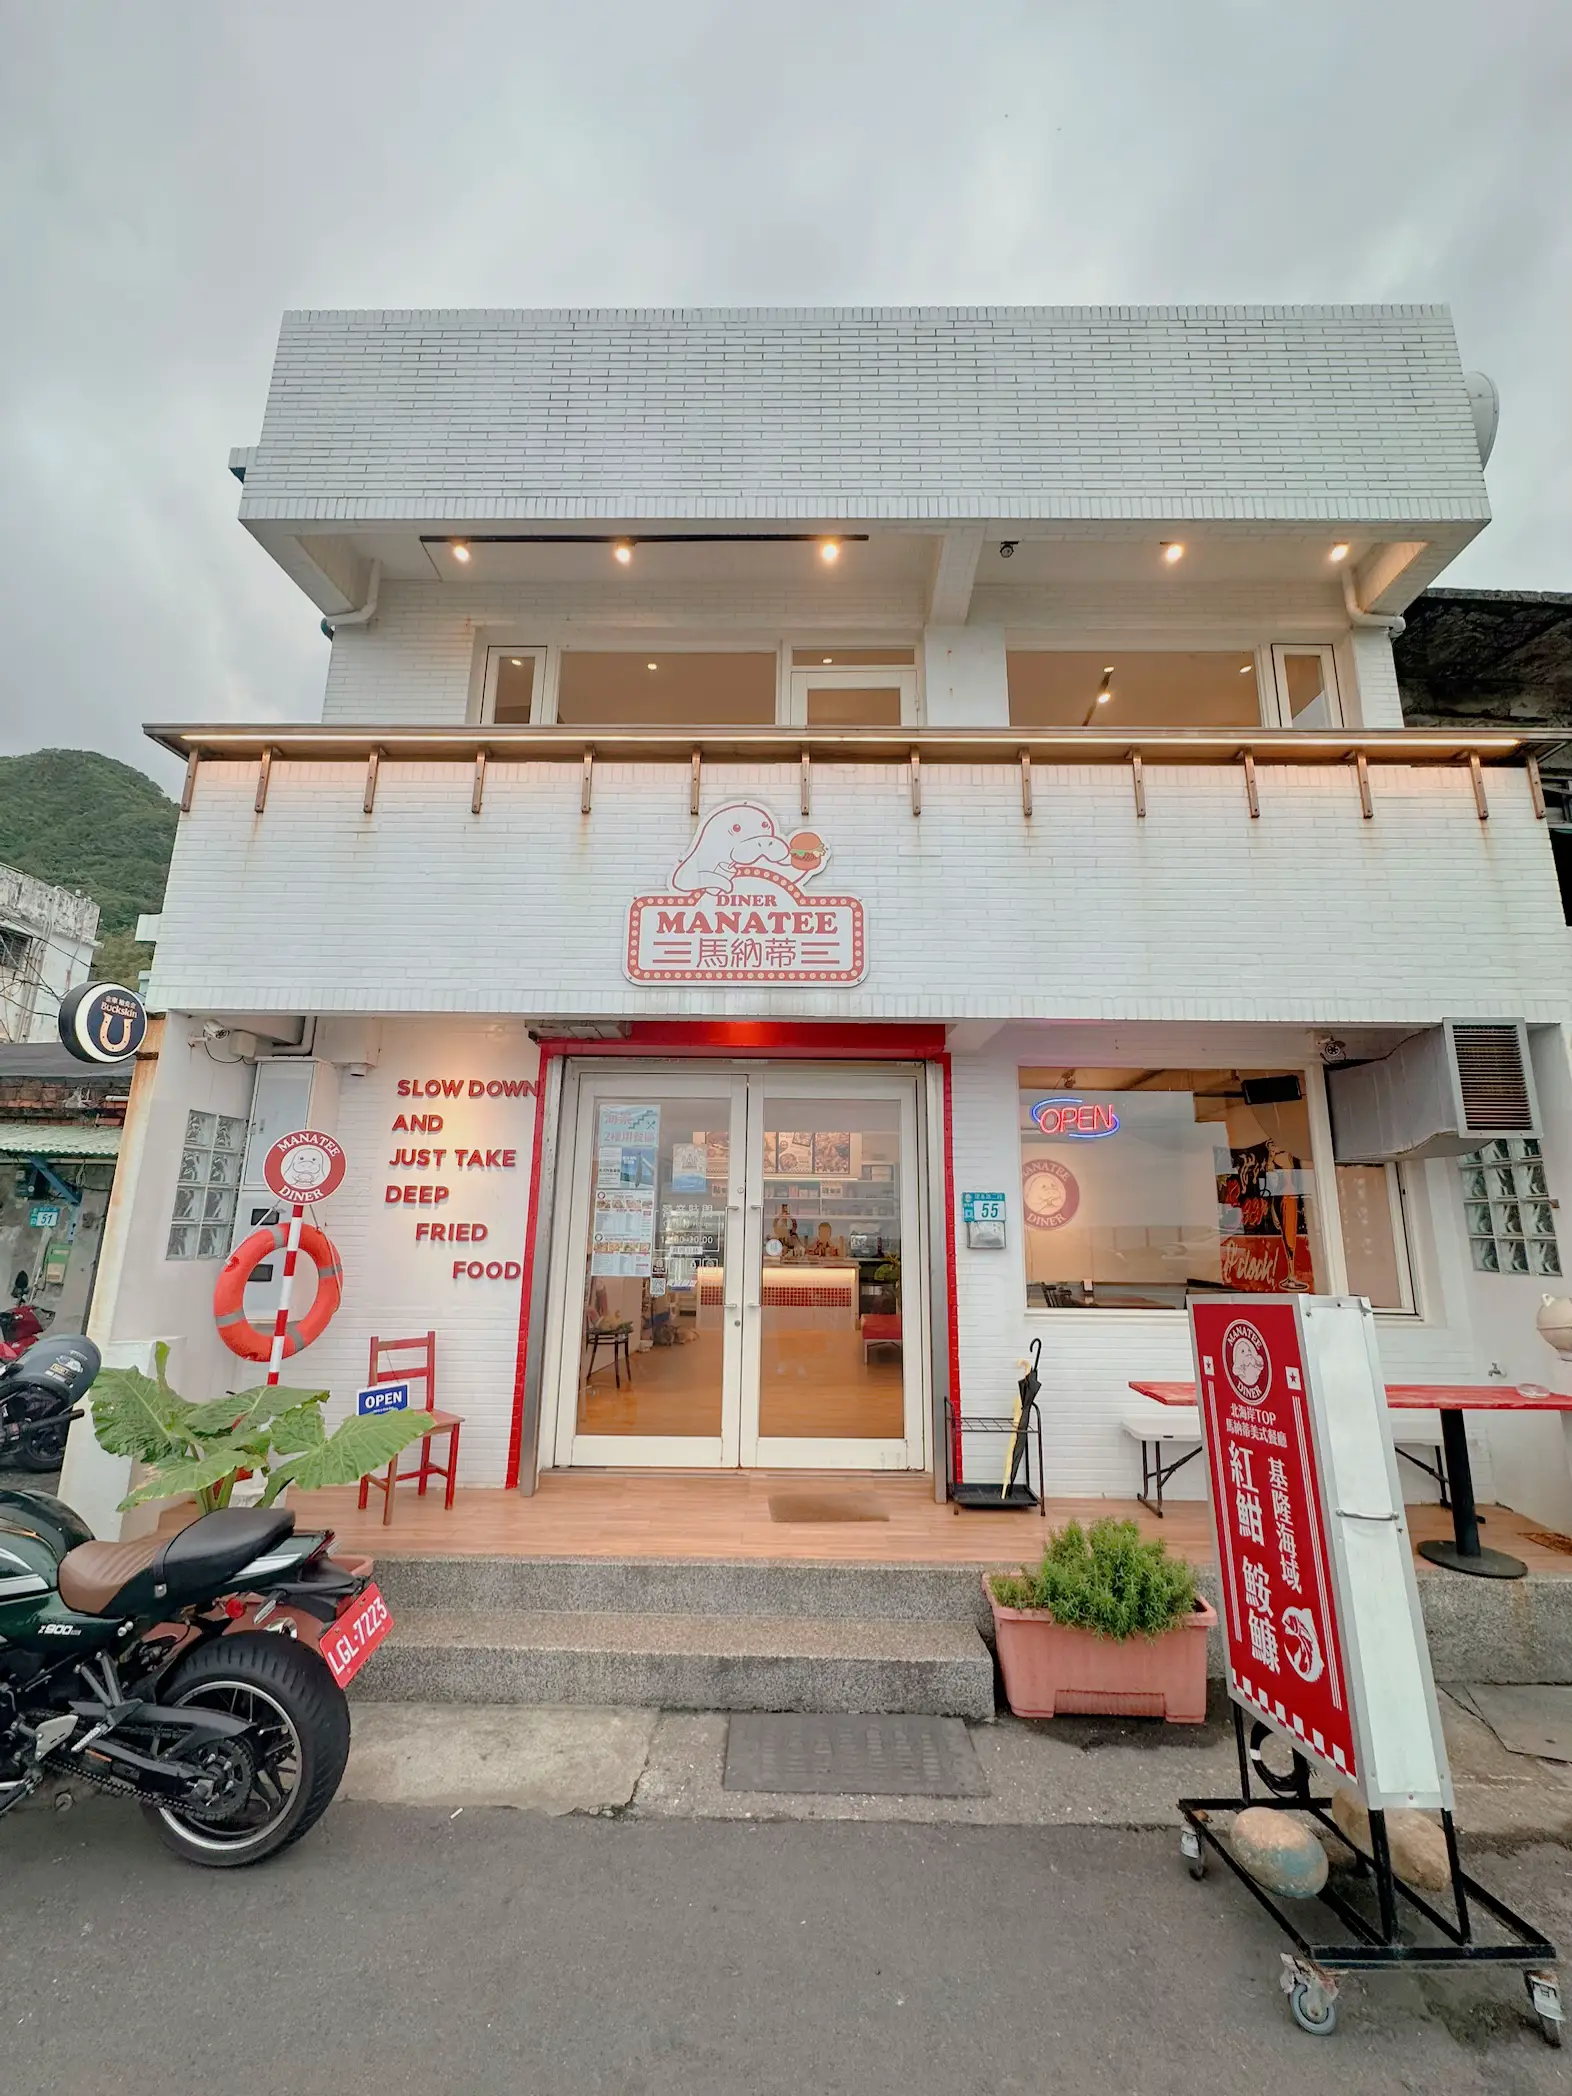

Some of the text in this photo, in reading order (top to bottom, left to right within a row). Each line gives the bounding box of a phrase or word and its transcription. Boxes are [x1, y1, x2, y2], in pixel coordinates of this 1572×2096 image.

[716, 894, 777, 907] DINER
[656, 911, 838, 935] MANATEE
[697, 938, 796, 968] 馬納蒂
[100, 1001, 138, 1018] Buckskin
[397, 1079, 540, 1097] SLOW DOWN
[392, 1114, 444, 1132] AND
[1039, 1104, 1113, 1134] OPEN
[277, 1132, 341, 1157] MANATEE
[389, 1148, 517, 1167] JUST TAKE
[1022, 1161, 1072, 1182] ANATEE
[278, 1185, 325, 1201] DINER
[385, 1185, 449, 1203] DEEP
[41, 1213, 53, 1225] 51
[981, 1203, 999, 1218] 55
[1026, 1213, 1067, 1227] DINER
[416, 1223, 489, 1241] FRIED
[453, 1261, 521, 1279] FOOD
[1227, 1326, 1262, 1350] MANATEE
[1237, 1381, 1262, 1399] DINER
[365, 1391, 403, 1409] OPEN
[1267, 1456, 1302, 1595] 基隆海域
